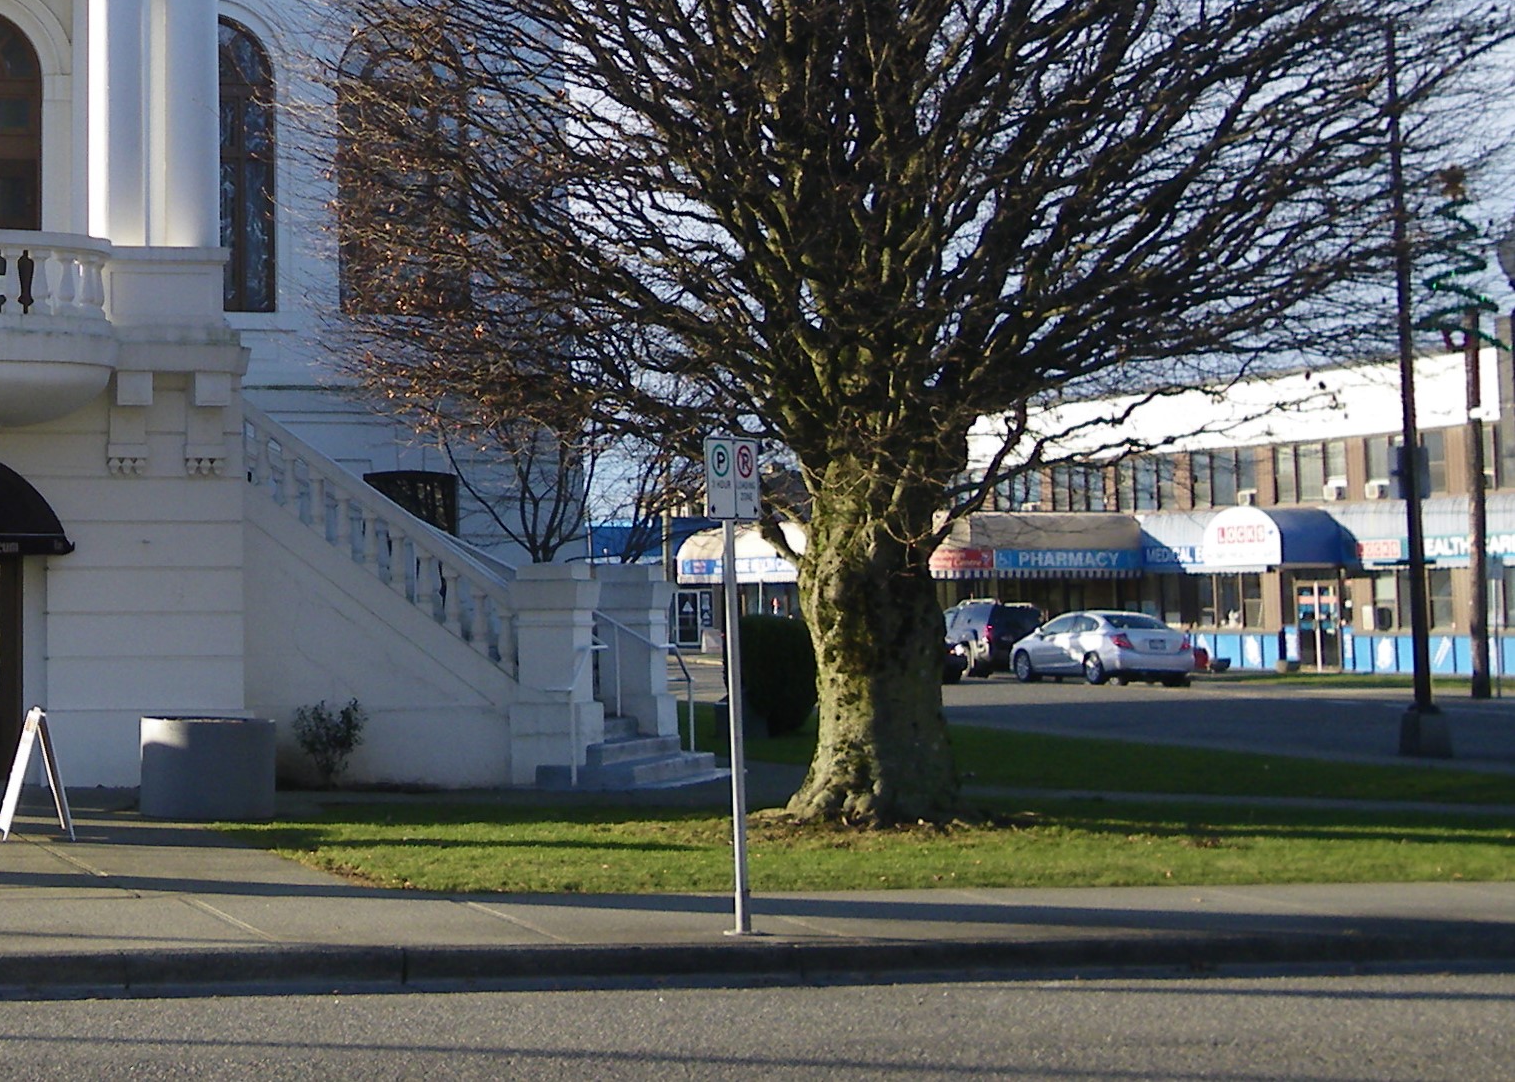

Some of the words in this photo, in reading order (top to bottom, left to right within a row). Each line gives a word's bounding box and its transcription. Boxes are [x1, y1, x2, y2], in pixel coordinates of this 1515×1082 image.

[1146, 546, 1195, 563] MEDICAL
[1422, 535, 1471, 556] EALTH
[1017, 550, 1121, 568] PHARMACY
